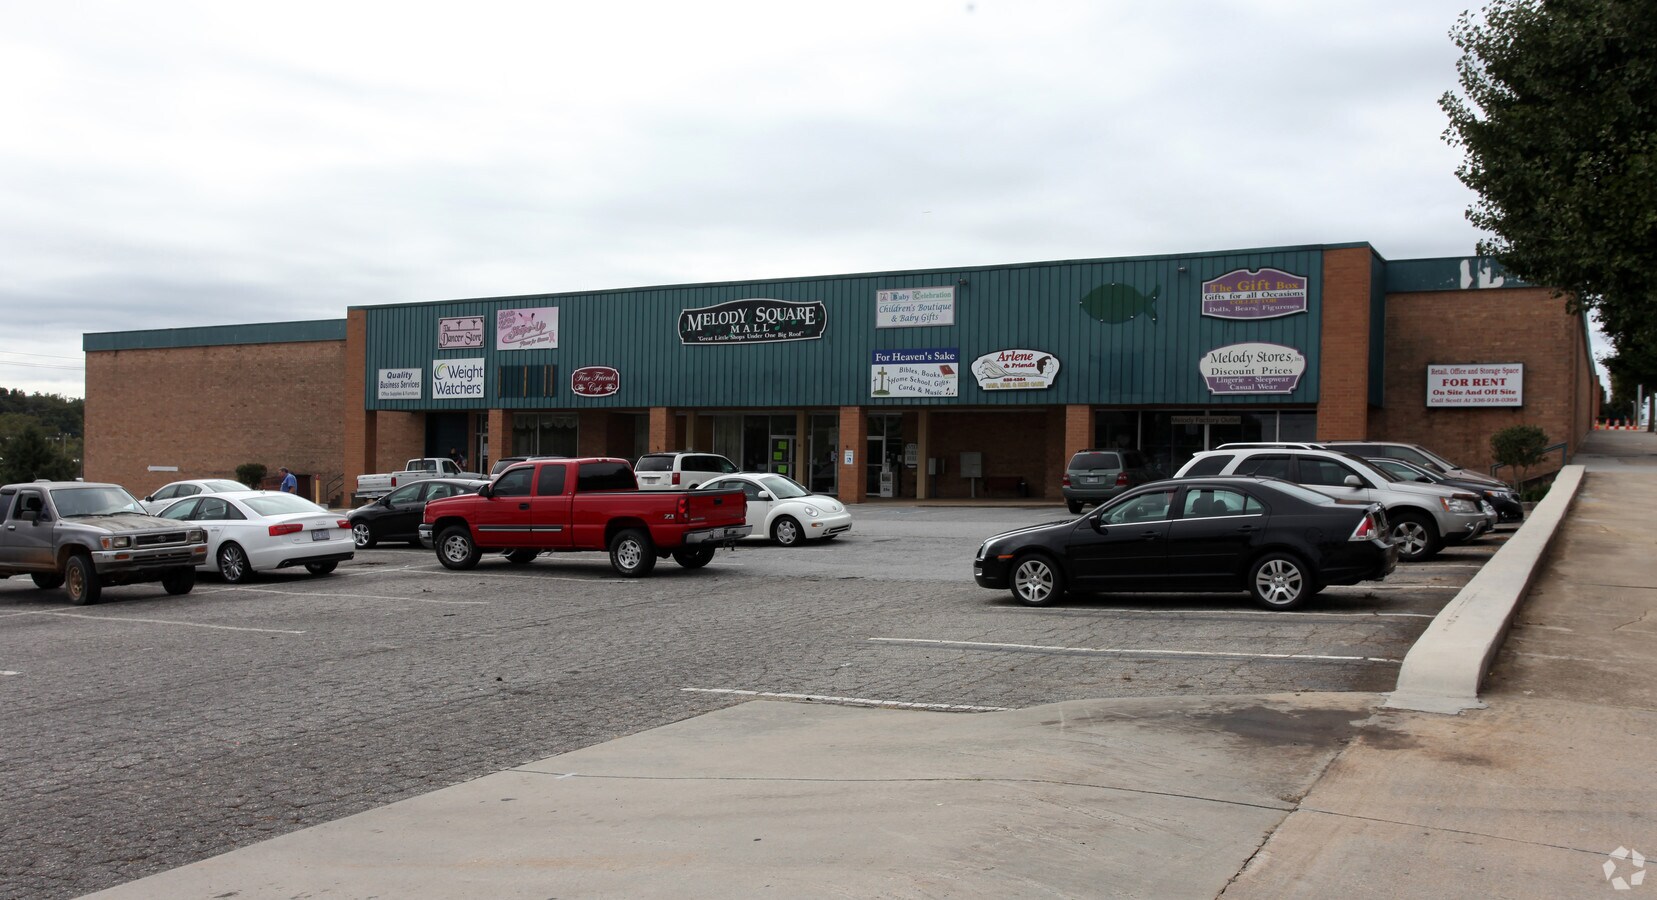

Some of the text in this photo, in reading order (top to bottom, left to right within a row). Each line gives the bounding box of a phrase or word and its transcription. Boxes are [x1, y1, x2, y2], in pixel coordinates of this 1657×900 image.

[1211, 284, 1231, 293] The
[1237, 280, 1271, 291] Gift
[891, 292, 910, 301] Baby
[913, 291, 951, 300] Celebration
[1261, 290, 1304, 298] Occasions
[879, 302, 952, 313] Children's Boutique
[687, 306, 816, 331] MELODY SQUARE
[900, 313, 919, 323] Baby
[921, 313, 939, 323] Gifts
[730, 324, 770, 333] MALL
[441, 331, 482, 346] Dancer Store
[875, 351, 955, 362] For Heaven's Sake
[996, 351, 1034, 362] Arlene
[1210, 350, 1254, 367] Melody
[1256, 351, 1294, 363] Stores,
[386, 371, 413, 380] Quality
[447, 364, 483, 382] Weight
[899, 367, 920, 375] Bibles,
[1211, 366, 1293, 375] Discount Prices
[1480, 367, 1501, 376] Storage
[1502, 367, 1519, 376] Space
[380, 380, 420, 389] Business Services
[1216, 377, 1245, 385] Lingerie
[1255, 376, 1290, 384] Sleepwear
[1442, 378, 1507, 387] FOR RENT
[434, 381, 482, 395] Watchers
[924, 388, 942, 396] Music
